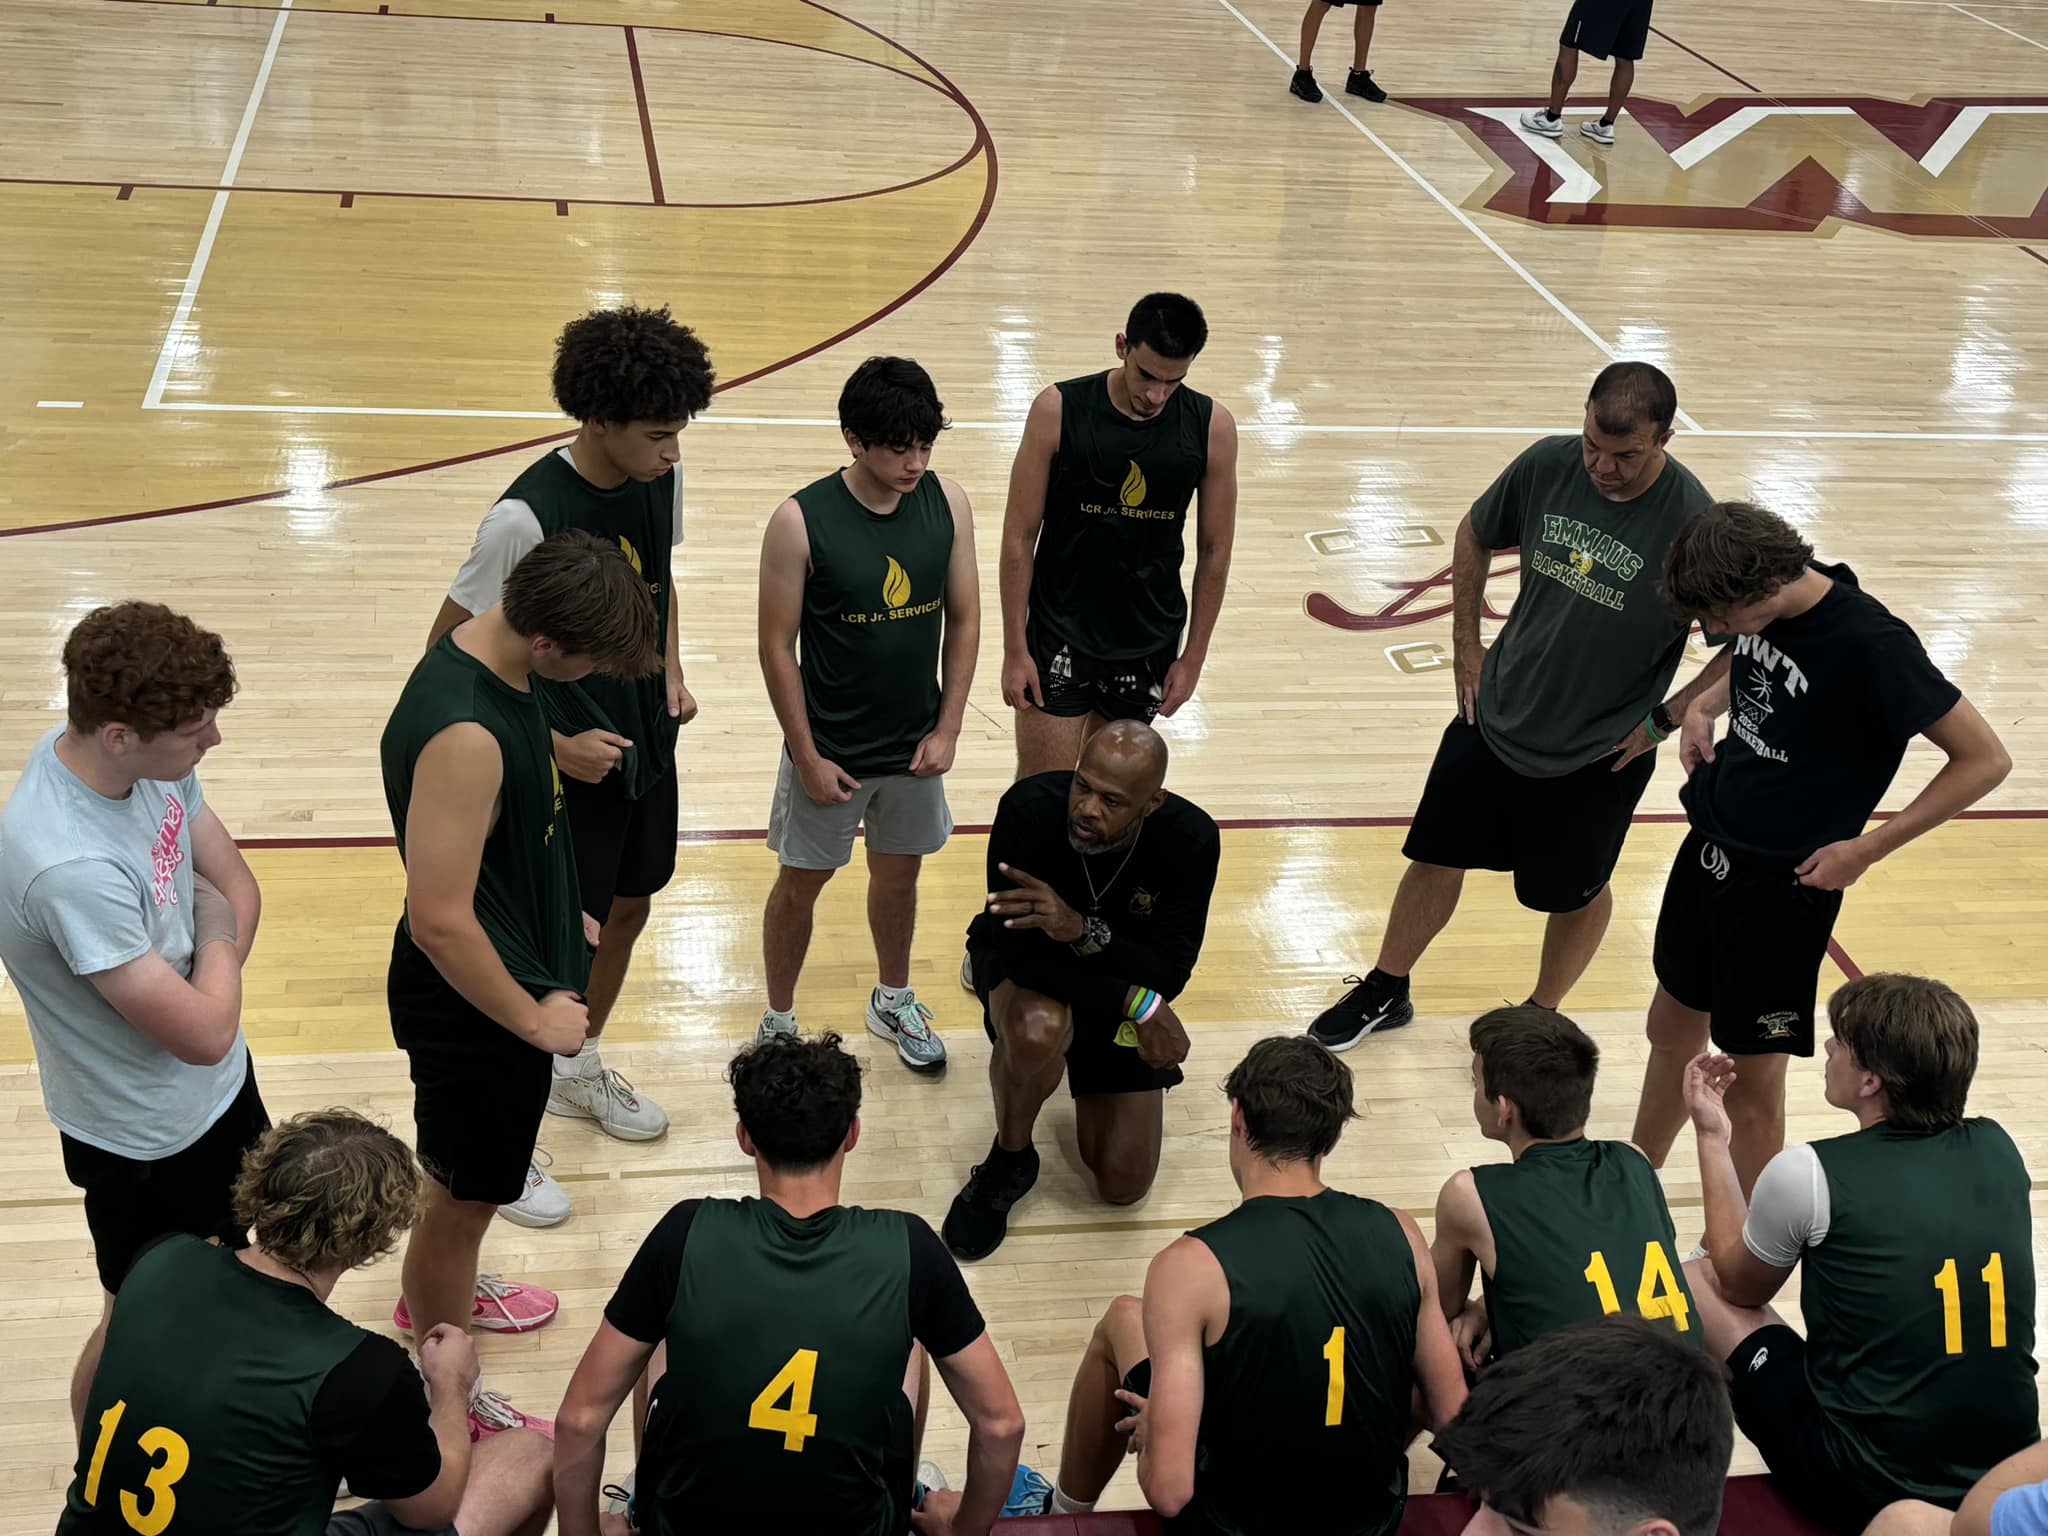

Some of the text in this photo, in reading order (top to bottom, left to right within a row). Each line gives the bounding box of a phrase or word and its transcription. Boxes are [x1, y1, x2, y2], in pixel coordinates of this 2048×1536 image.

[1080, 503, 1175, 520] LCR Jr. SERVICES
[1543, 514, 1644, 581] EMMAUS
[841, 613, 867, 623] LCR
[870, 612, 886, 623] Jr.
[1531, 550, 1624, 611] BASKETBALL
[1733, 633, 1808, 698] NWT
[1584, 1241, 1689, 1332] 14
[1934, 1252, 2007, 1355] 11
[748, 1348, 819, 1452] 4
[1323, 1326, 1345, 1426] 1
[84, 1400, 190, 1536] 13
